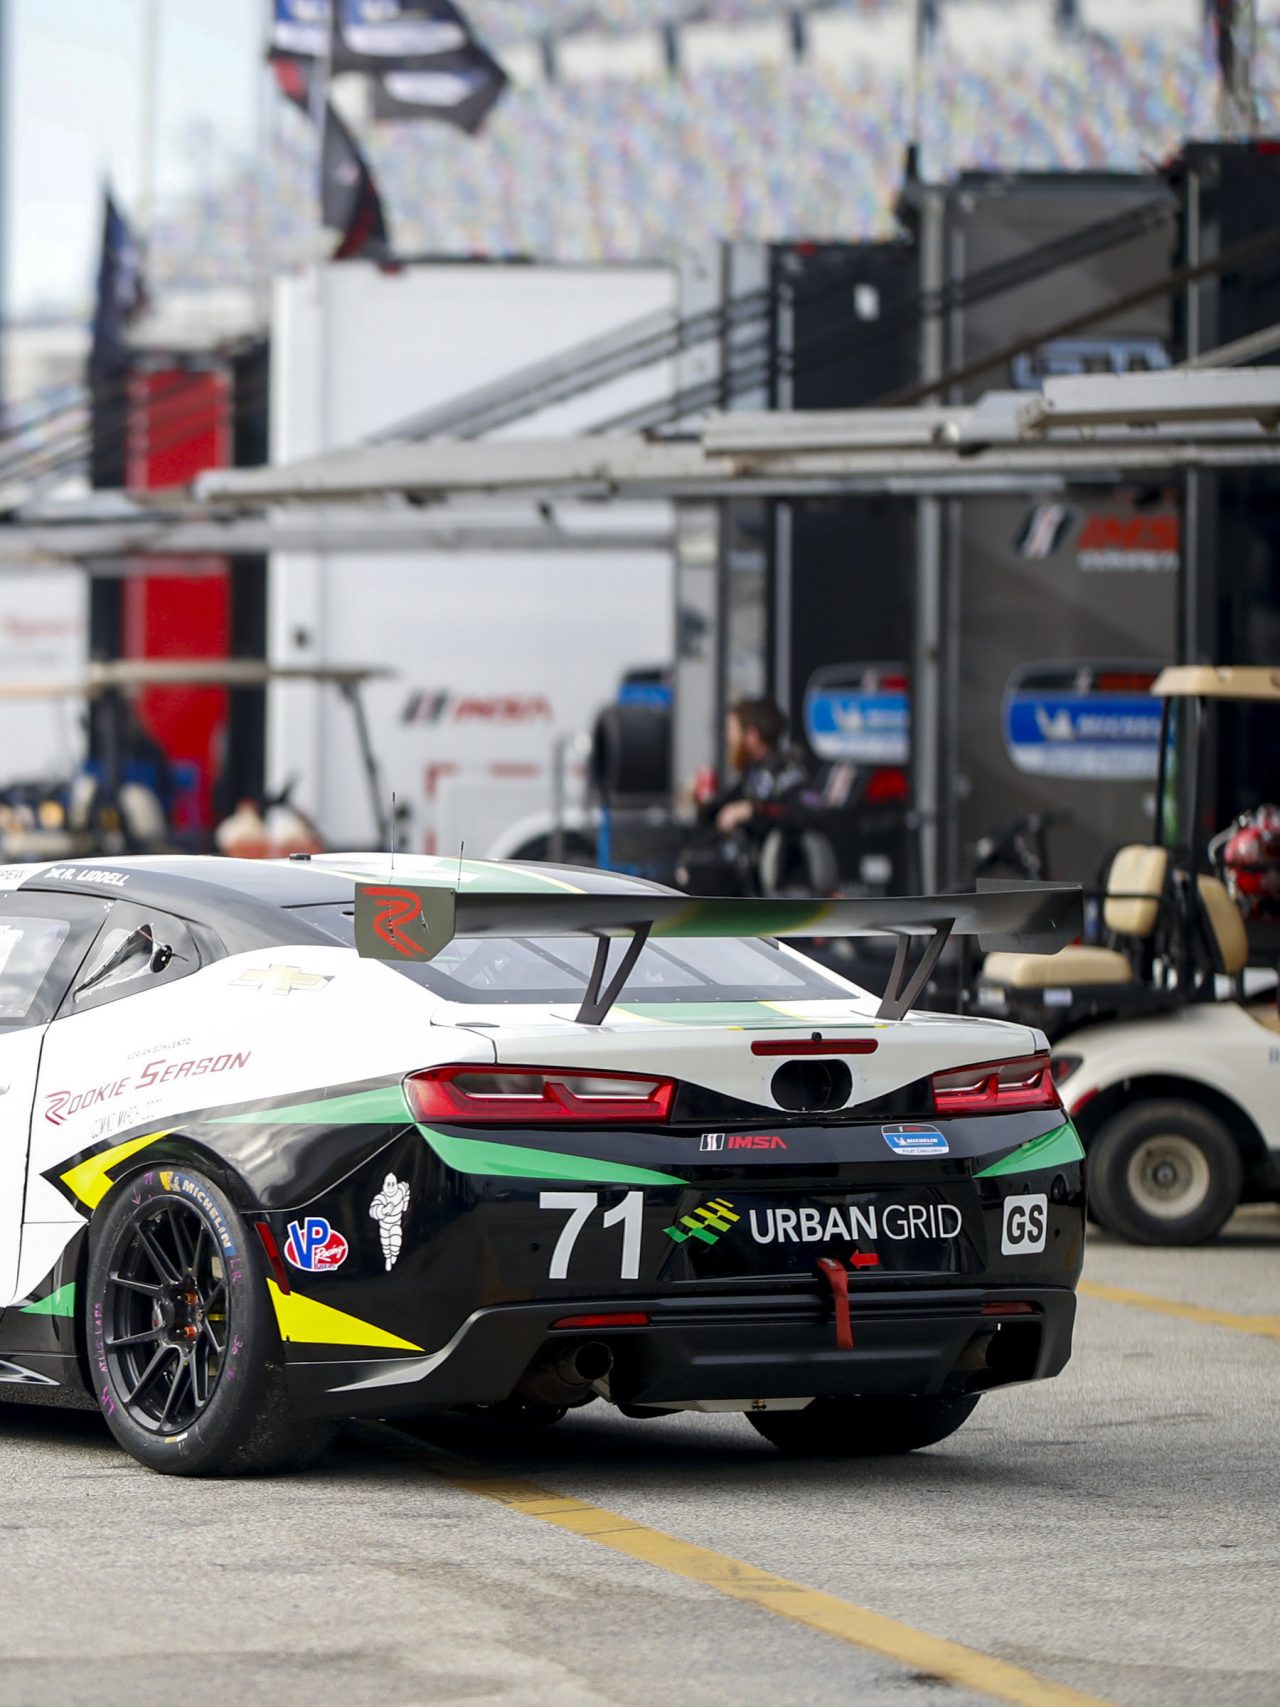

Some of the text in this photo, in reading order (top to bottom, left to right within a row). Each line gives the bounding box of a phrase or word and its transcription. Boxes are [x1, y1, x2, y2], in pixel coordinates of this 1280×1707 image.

[77, 869, 130, 886] LIDDELL
[135, 1051, 252, 1089] SEASON
[728, 1135, 788, 1149] IMSA
[182, 1179, 232, 1249] MICHELIN
[1006, 1203, 1045, 1244] GS
[288, 1217, 330, 1269] VP
[539, 1191, 644, 1280] 71
